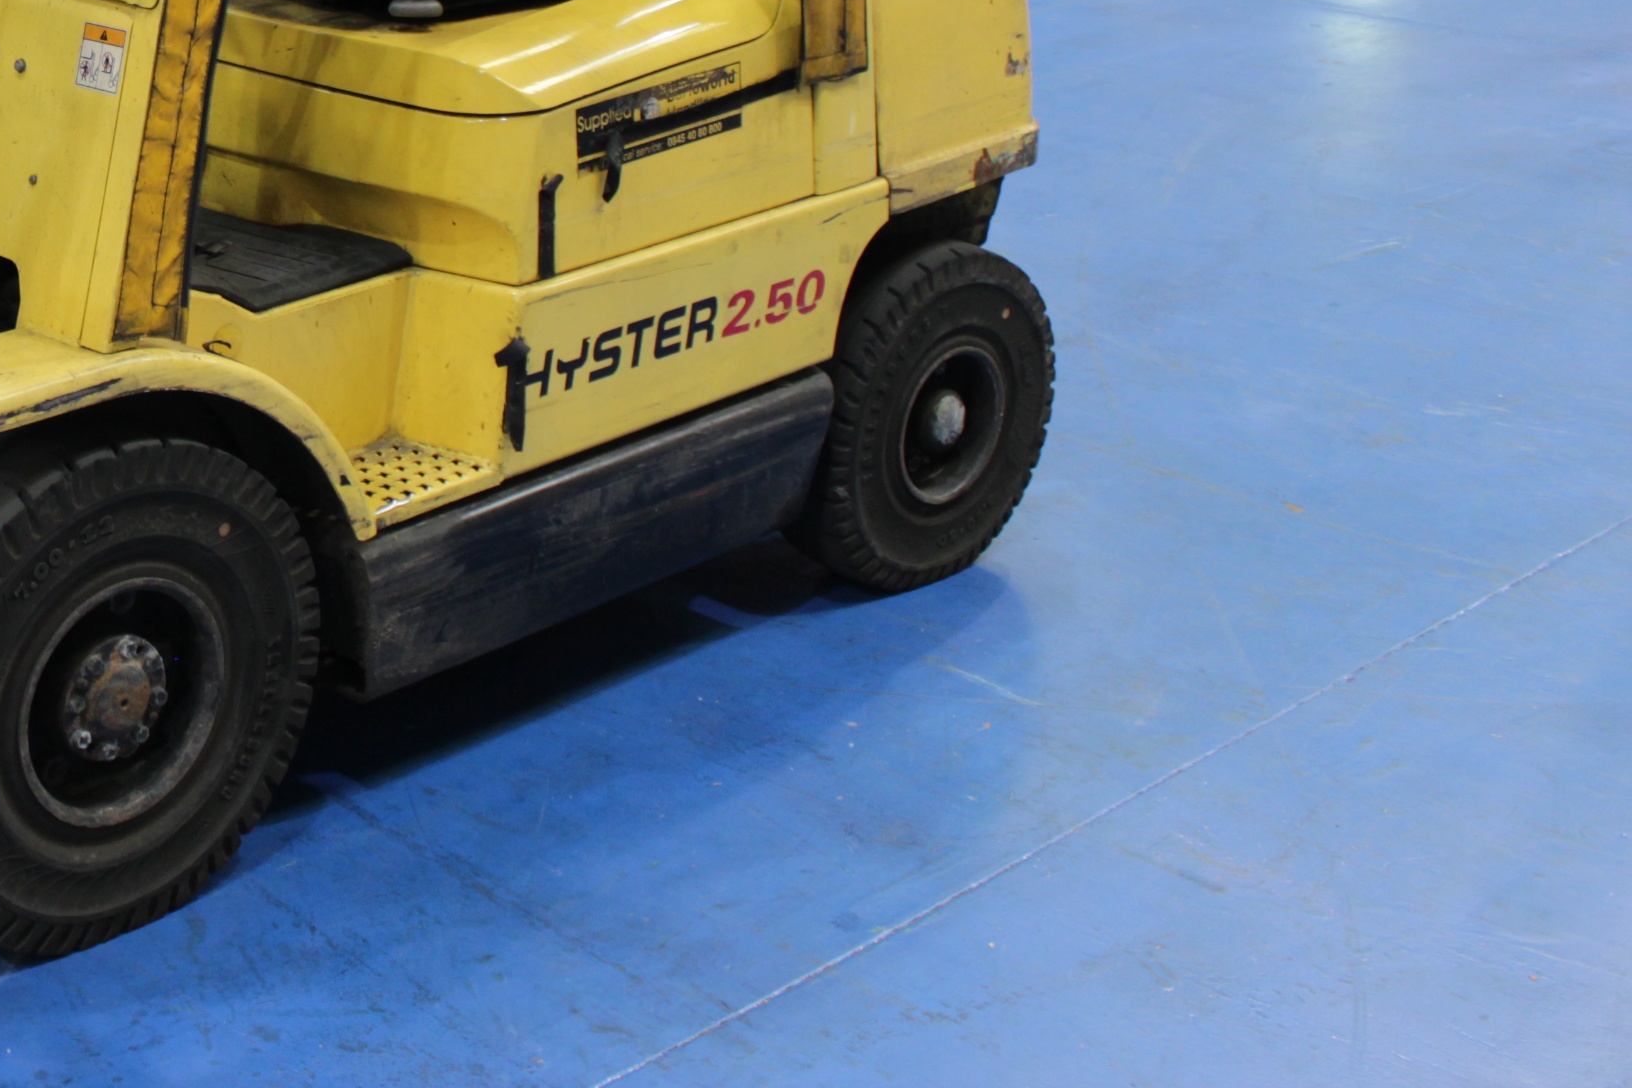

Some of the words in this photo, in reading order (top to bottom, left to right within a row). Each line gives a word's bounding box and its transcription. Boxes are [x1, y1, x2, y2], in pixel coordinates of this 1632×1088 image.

[577, 107, 632, 134] Supplied
[686, 130, 697, 142] 40
[525, 296, 718, 398] HYSTER
[721, 269, 825, 338] 2.50
